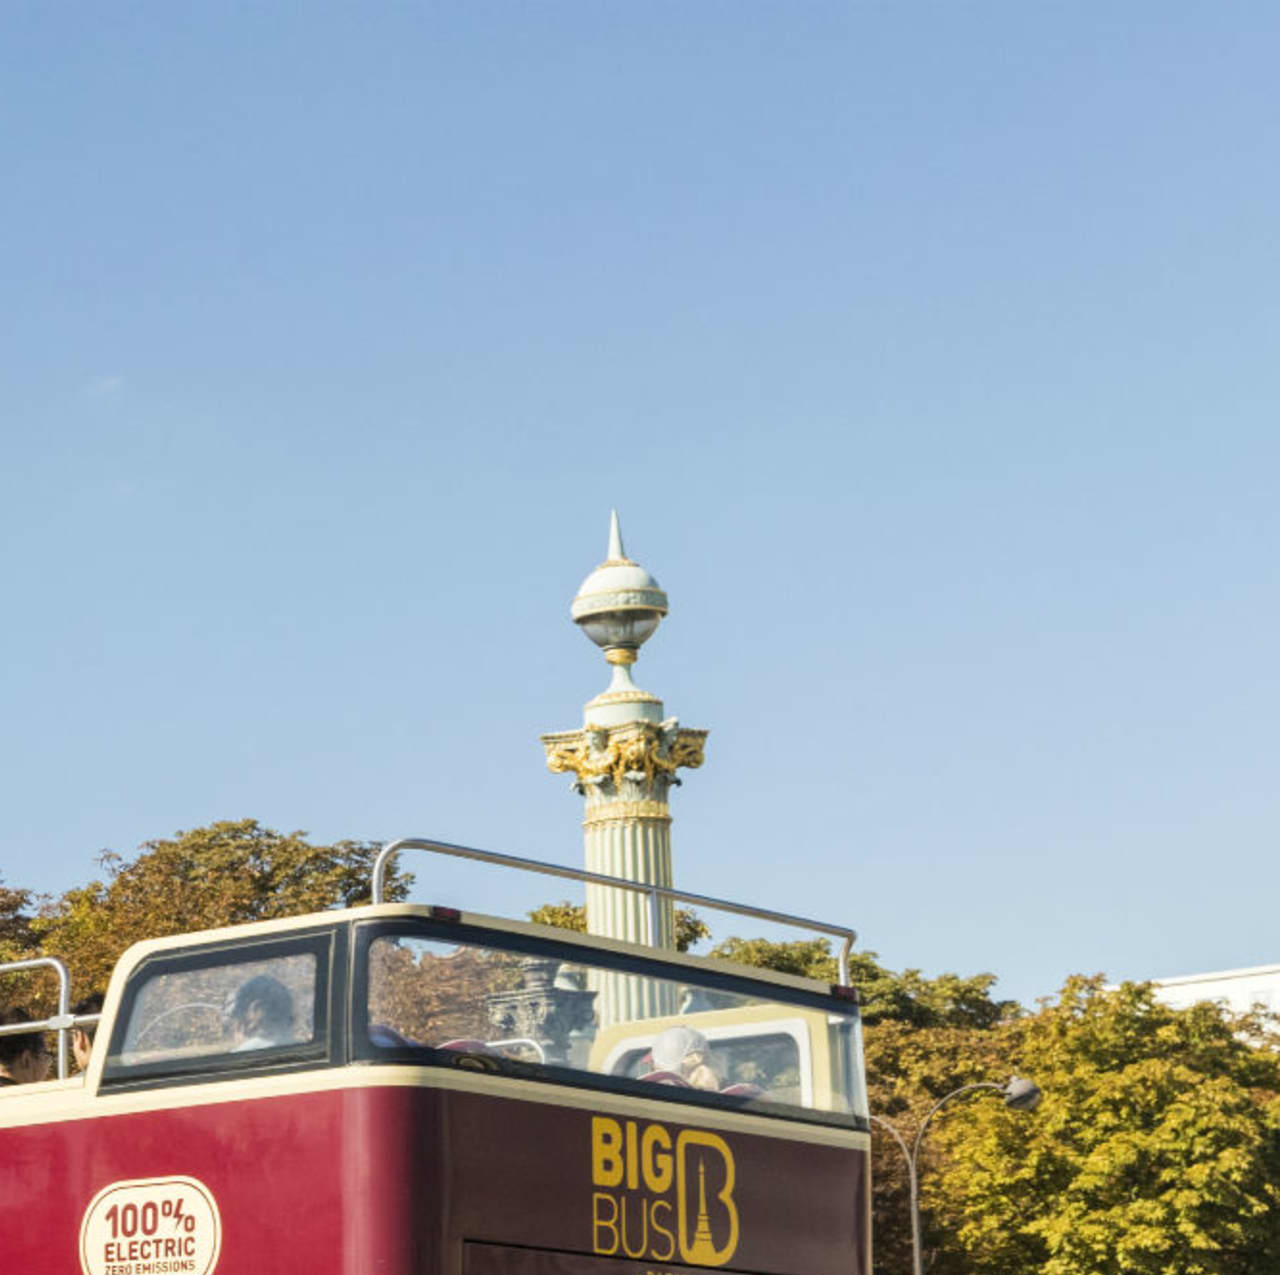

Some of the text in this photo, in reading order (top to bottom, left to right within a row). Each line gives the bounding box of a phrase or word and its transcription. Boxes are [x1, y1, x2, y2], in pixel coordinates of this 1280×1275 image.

[592, 1116, 673, 1193] BIG
[104, 1198, 196, 1239] 100%
[593, 1192, 675, 1261] BUS
[104, 1237, 196, 1263] ELECTRIC
[135, 1260, 196, 1275] EMISSIONS
